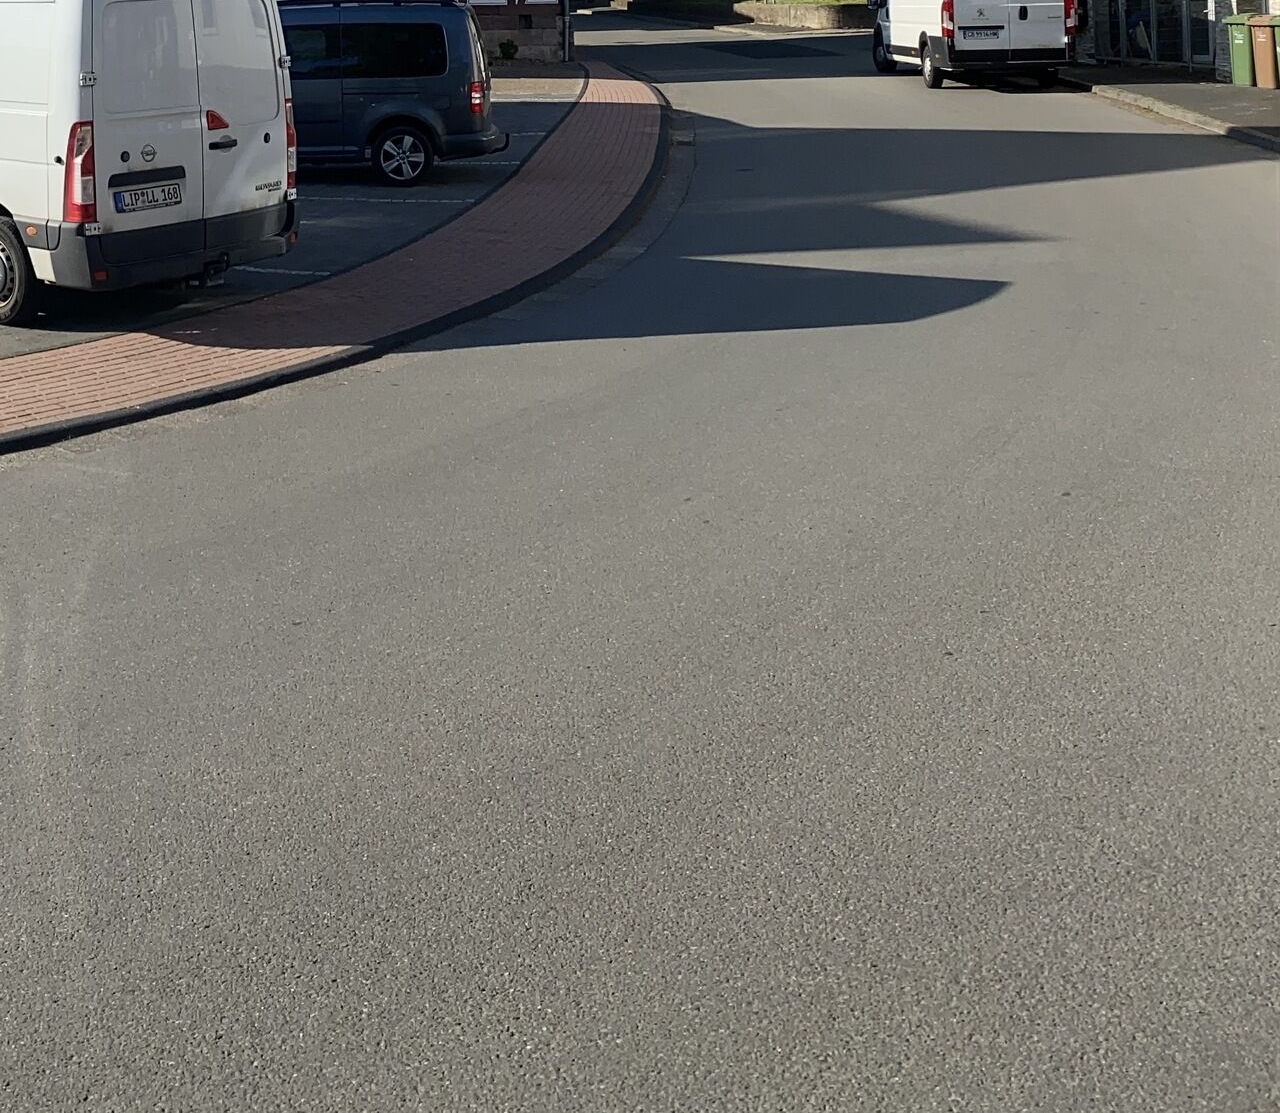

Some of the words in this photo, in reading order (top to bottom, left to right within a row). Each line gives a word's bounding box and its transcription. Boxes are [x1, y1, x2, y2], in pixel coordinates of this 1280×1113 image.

[122, 191, 140, 207] LIP
[146, 189, 159, 204] LL
[161, 186, 179, 202] 168
